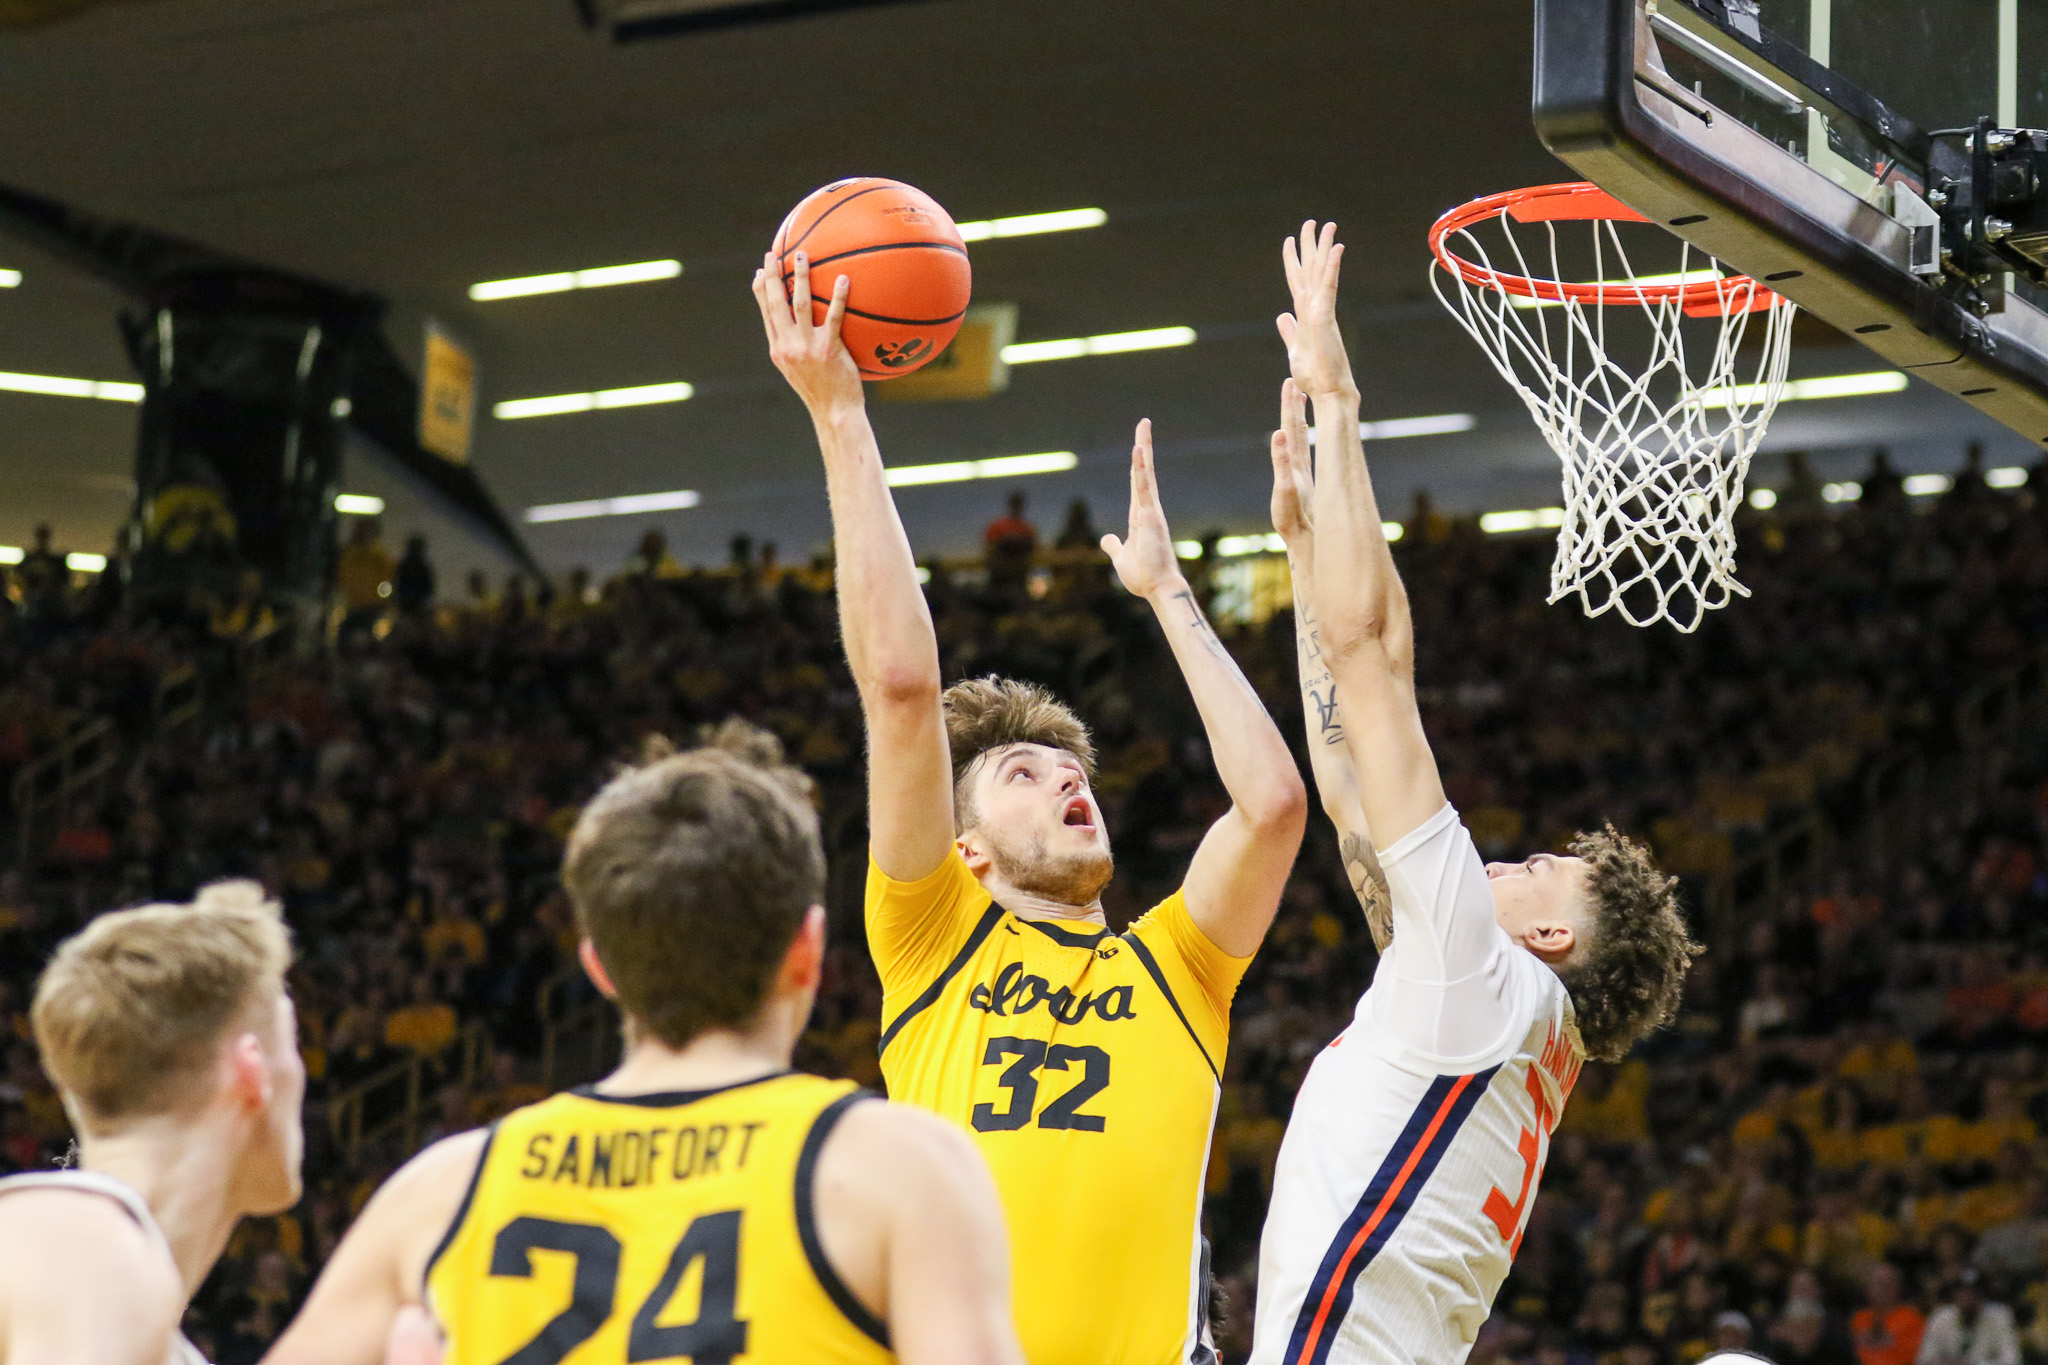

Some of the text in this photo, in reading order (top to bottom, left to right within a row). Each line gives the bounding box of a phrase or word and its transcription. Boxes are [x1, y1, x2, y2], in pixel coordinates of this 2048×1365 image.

[970, 961, 1137, 1025] Iowa
[971, 1036, 1110, 1133] 32
[521, 1121, 768, 1189] SANDFORT
[488, 1209, 751, 1365] 24
